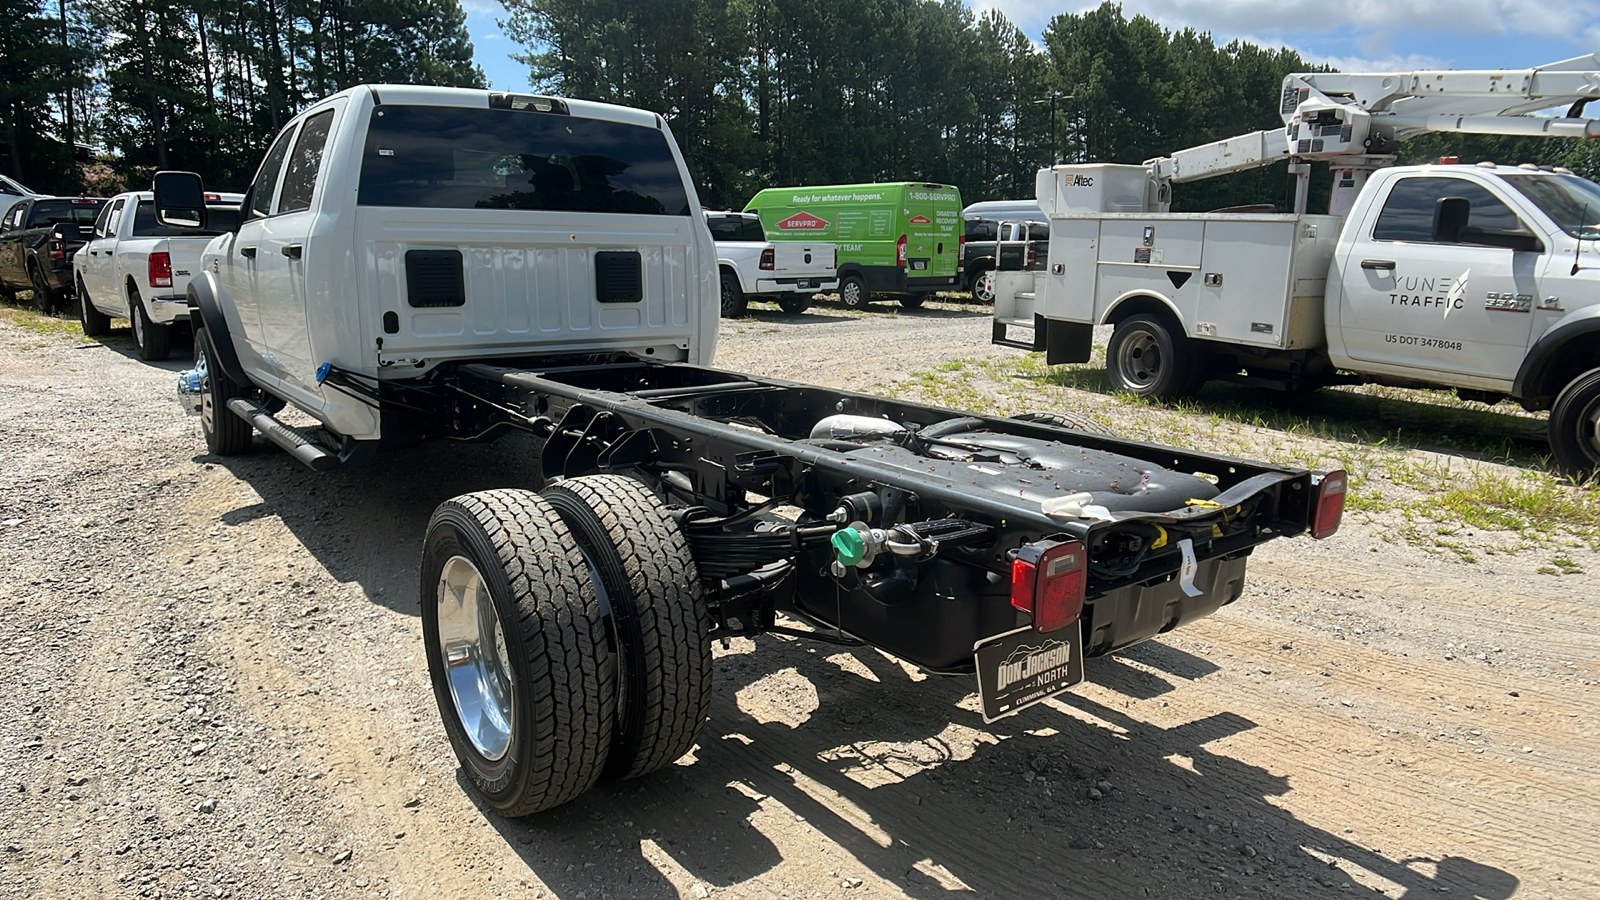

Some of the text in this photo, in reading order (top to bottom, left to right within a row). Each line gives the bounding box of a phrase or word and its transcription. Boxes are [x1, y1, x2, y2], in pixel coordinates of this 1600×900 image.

[1073, 174, 1093, 187] Altec
[792, 195, 810, 203] Ready
[822, 194, 851, 202] whatever
[852, 193, 882, 202] happens.
[909, 191, 956, 201] 1-800-SERVPRO
[786, 220, 816, 228] SERVPRO
[843, 243, 861, 252] TEAM
[1392, 275, 1468, 294] YUNEX
[1389, 293, 1465, 310] TRAFFIC
[1385, 334, 1463, 352] US DOT 3478048
[1037, 664, 1068, 687] NORTH
[1016, 685, 1056, 705] CUMMING, GA
